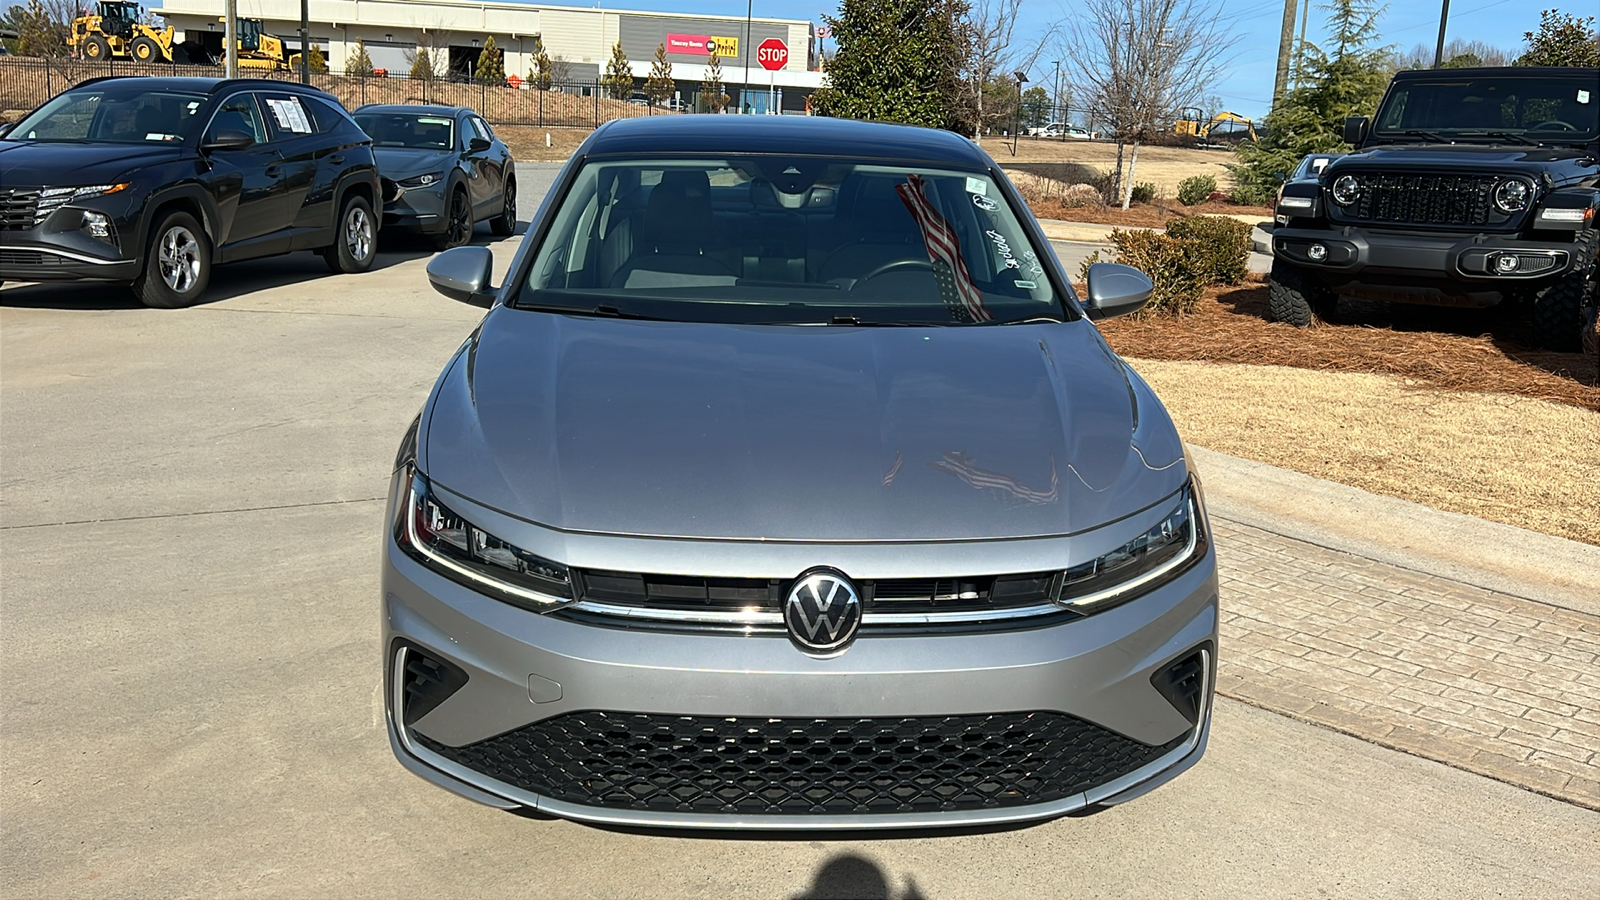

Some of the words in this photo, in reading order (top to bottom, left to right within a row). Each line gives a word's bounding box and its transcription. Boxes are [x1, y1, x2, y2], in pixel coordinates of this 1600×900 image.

[671, 39, 688, 47] Yancey
[759, 48, 787, 62] STOP
[788, 577, 858, 644] VW
